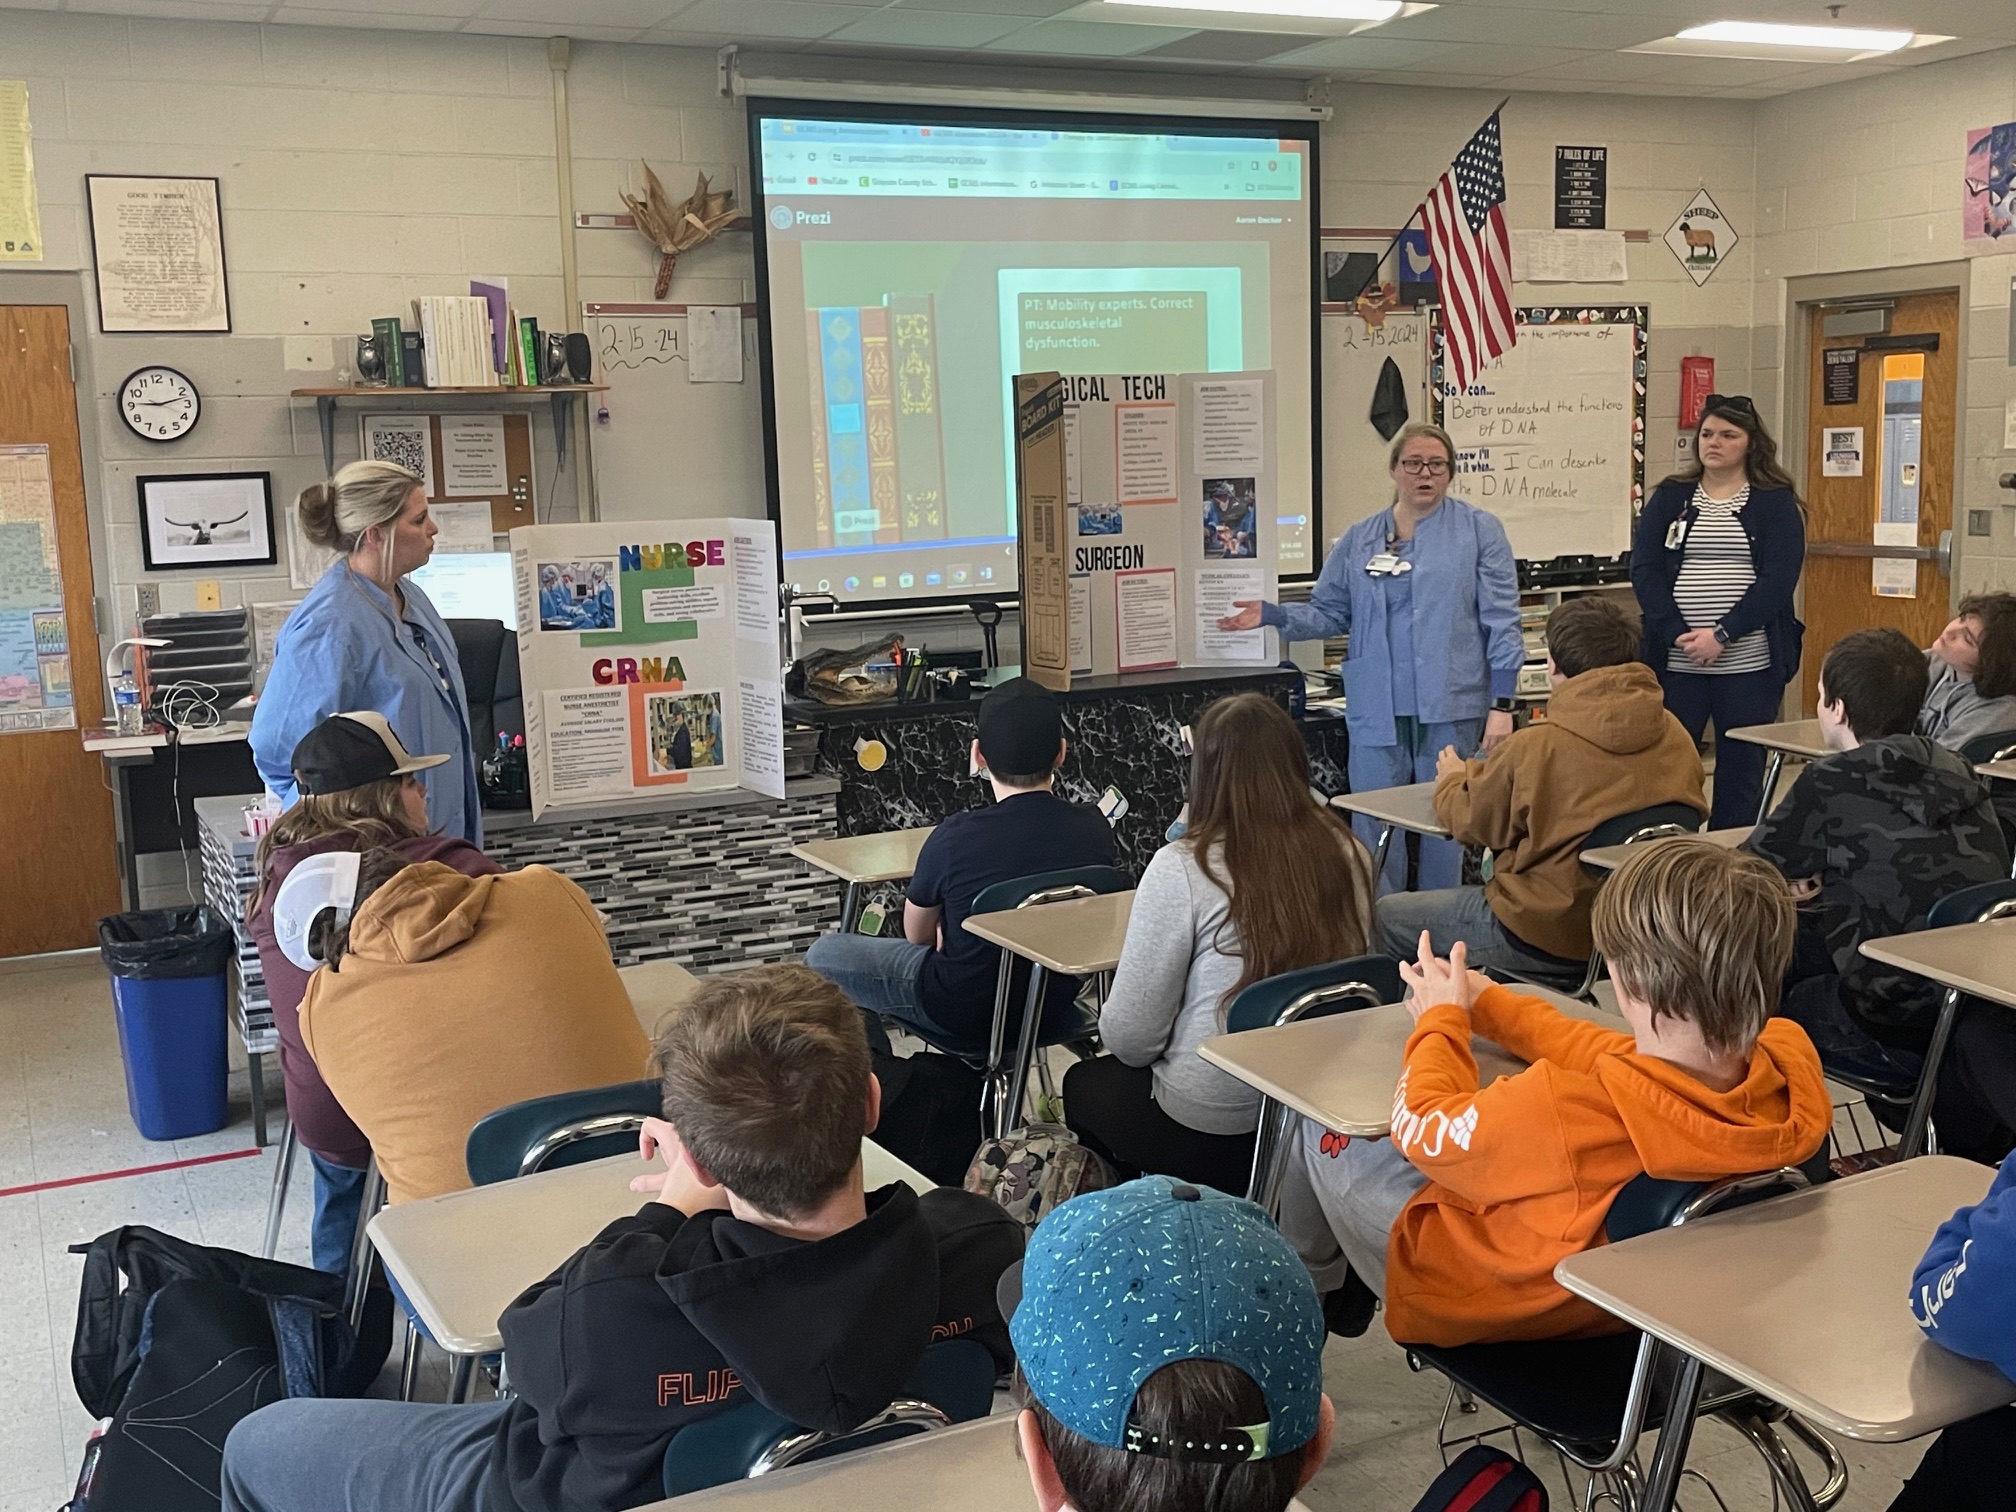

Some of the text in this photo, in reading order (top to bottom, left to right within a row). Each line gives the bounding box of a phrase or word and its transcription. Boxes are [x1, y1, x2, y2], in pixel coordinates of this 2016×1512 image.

[1583, 150, 1590, 160] OF
[1592, 150, 1604, 160] LIFE
[795, 210, 831, 225] Prezi
[1684, 207, 1719, 220] SHEEP
[1024, 297, 1194, 314] PT: Mobility experts. Correct
[1025, 315, 1123, 331] musculoskeletal
[1597, 327, 1613, 340] of
[1025, 335, 1100, 351] dysfunction.
[140, 379, 147, 388] 11
[151, 374, 163, 384] 12
[170, 378, 173, 386] 1
[130, 389, 142, 398] 10
[178, 387, 186, 396] 2
[1121, 375, 1165, 400] TECH
[1445, 383, 1456, 397] So
[128, 402, 135, 411] 9
[184, 400, 191, 408] 3
[1452, 398, 1493, 420] Better
[1498, 402, 1550, 415] understand
[1558, 399, 1572, 412] the
[133, 414, 141, 423] 8
[180, 412, 188, 421] 4
[1021, 405, 1047, 433] BOARD
[144, 423, 152, 432] 7
[159, 426, 167, 435] 6
[172, 422, 180, 431] 5
[1479, 421, 1495, 437] of
[1831, 433, 1855, 444] BEST
[1503, 453, 1519, 470] I
[1528, 456, 1553, 469] Can
[1482, 475, 1528, 498] DNA
[854, 516, 874, 526] Prezi
[619, 540, 725, 571] NURSE
[1075, 545, 1144, 571] SURGEON
[592, 656, 687, 684] CRNA
